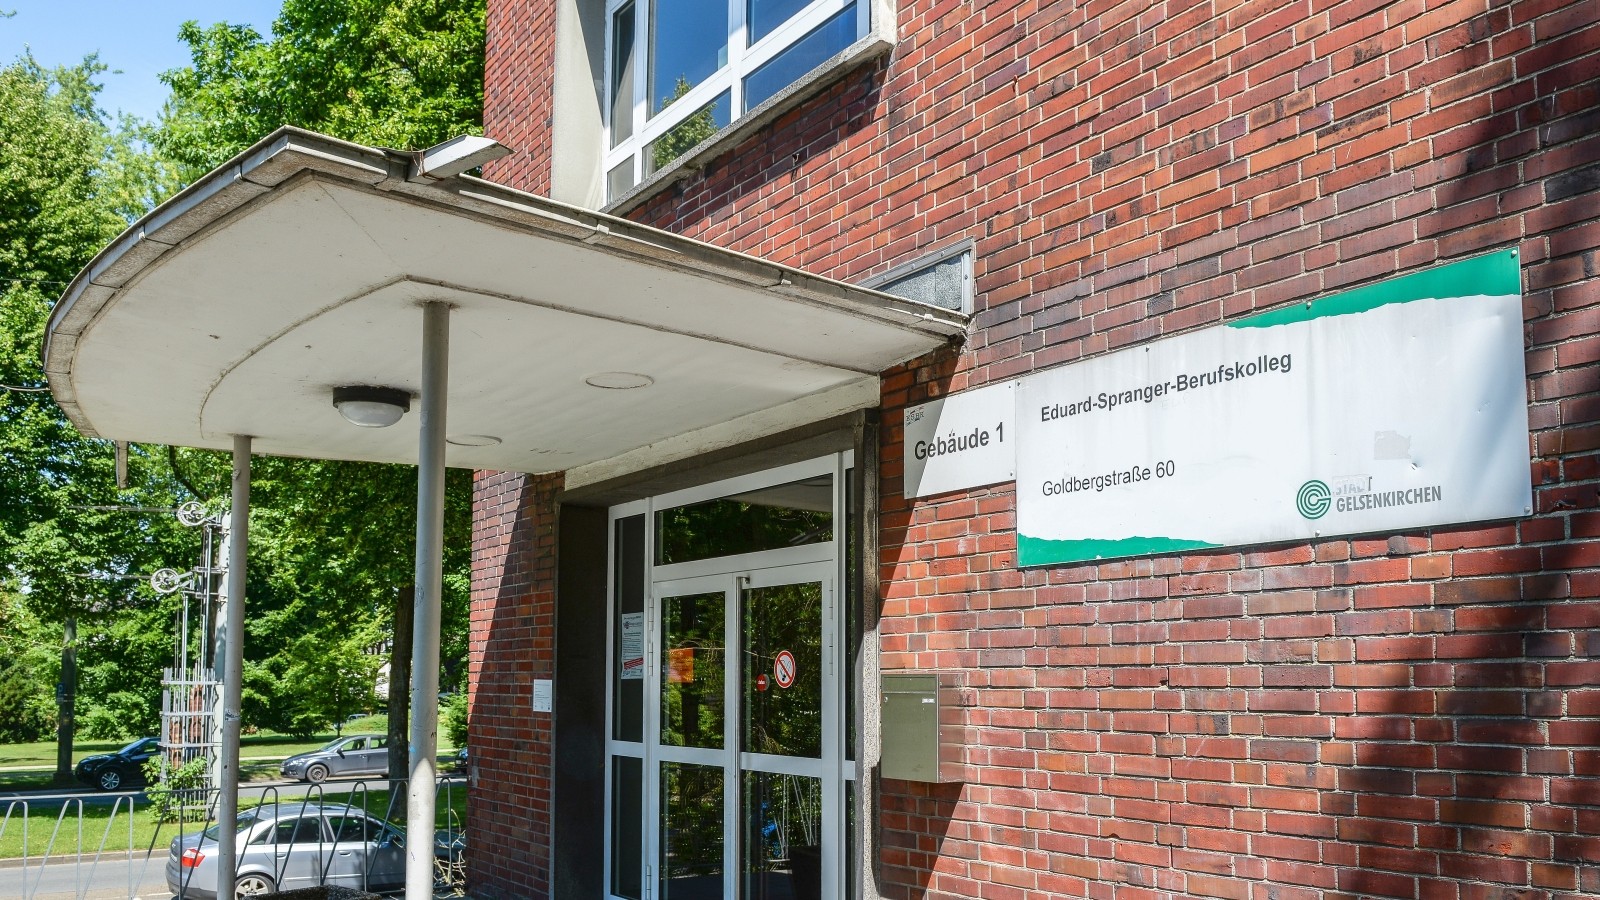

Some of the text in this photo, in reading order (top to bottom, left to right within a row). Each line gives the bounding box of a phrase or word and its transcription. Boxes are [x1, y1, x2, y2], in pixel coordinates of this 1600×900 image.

[1041, 353, 1292, 422] Eduard-Spranger-Berufskolleg
[914, 421, 1004, 460] Gebäude 1
[1042, 459, 1175, 496] Goldbergstraße 60
[1336, 485, 1442, 513] GELSENKIRCHEN
